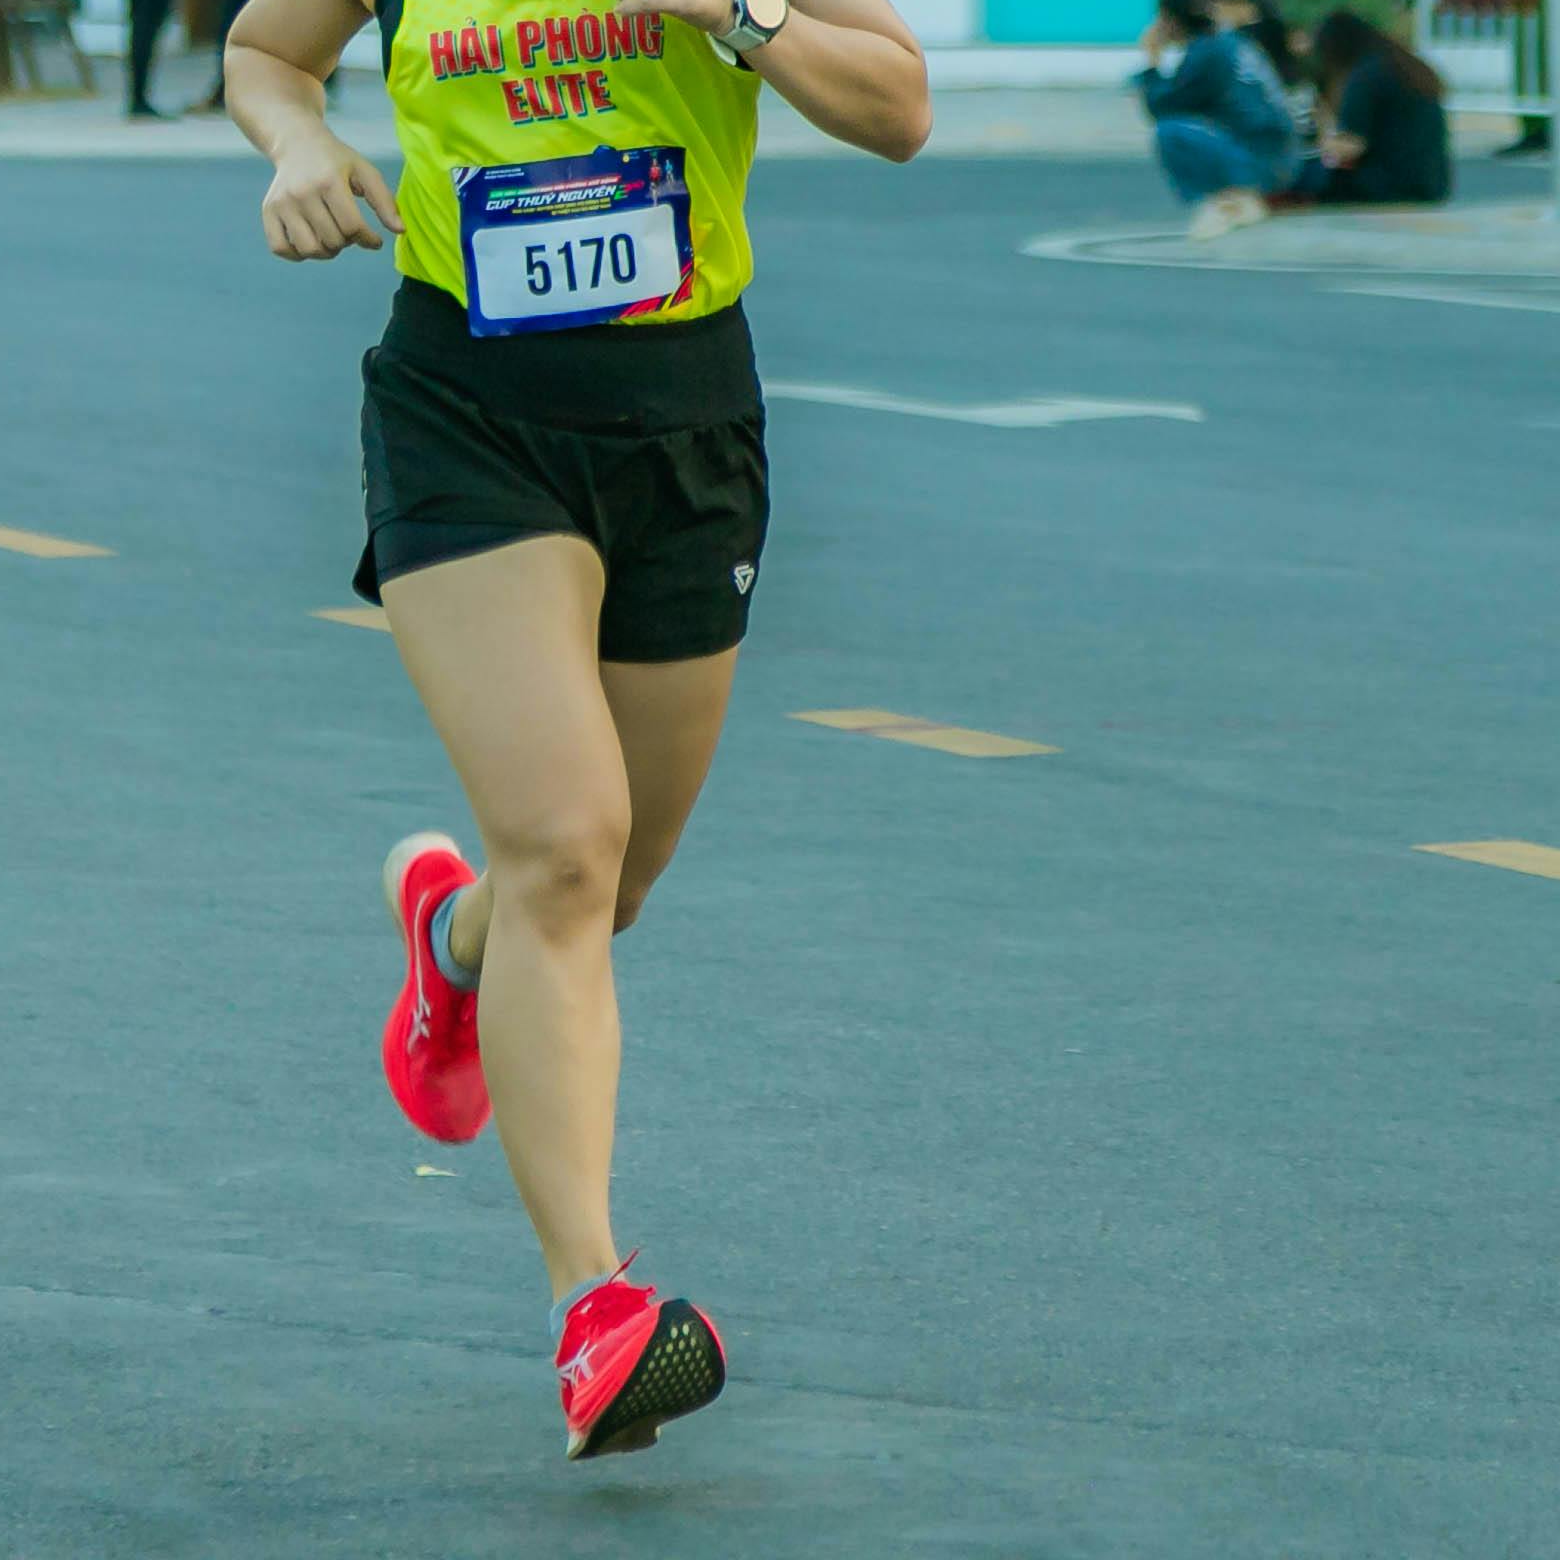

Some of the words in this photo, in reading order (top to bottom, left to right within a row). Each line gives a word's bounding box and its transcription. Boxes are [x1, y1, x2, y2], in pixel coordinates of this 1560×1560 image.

[429, 16, 505, 81] HẢI
[516, 8, 665, 69] PHÒNG
[501, 70, 617, 126] ELITE
[525, 233, 637, 297] 5170
